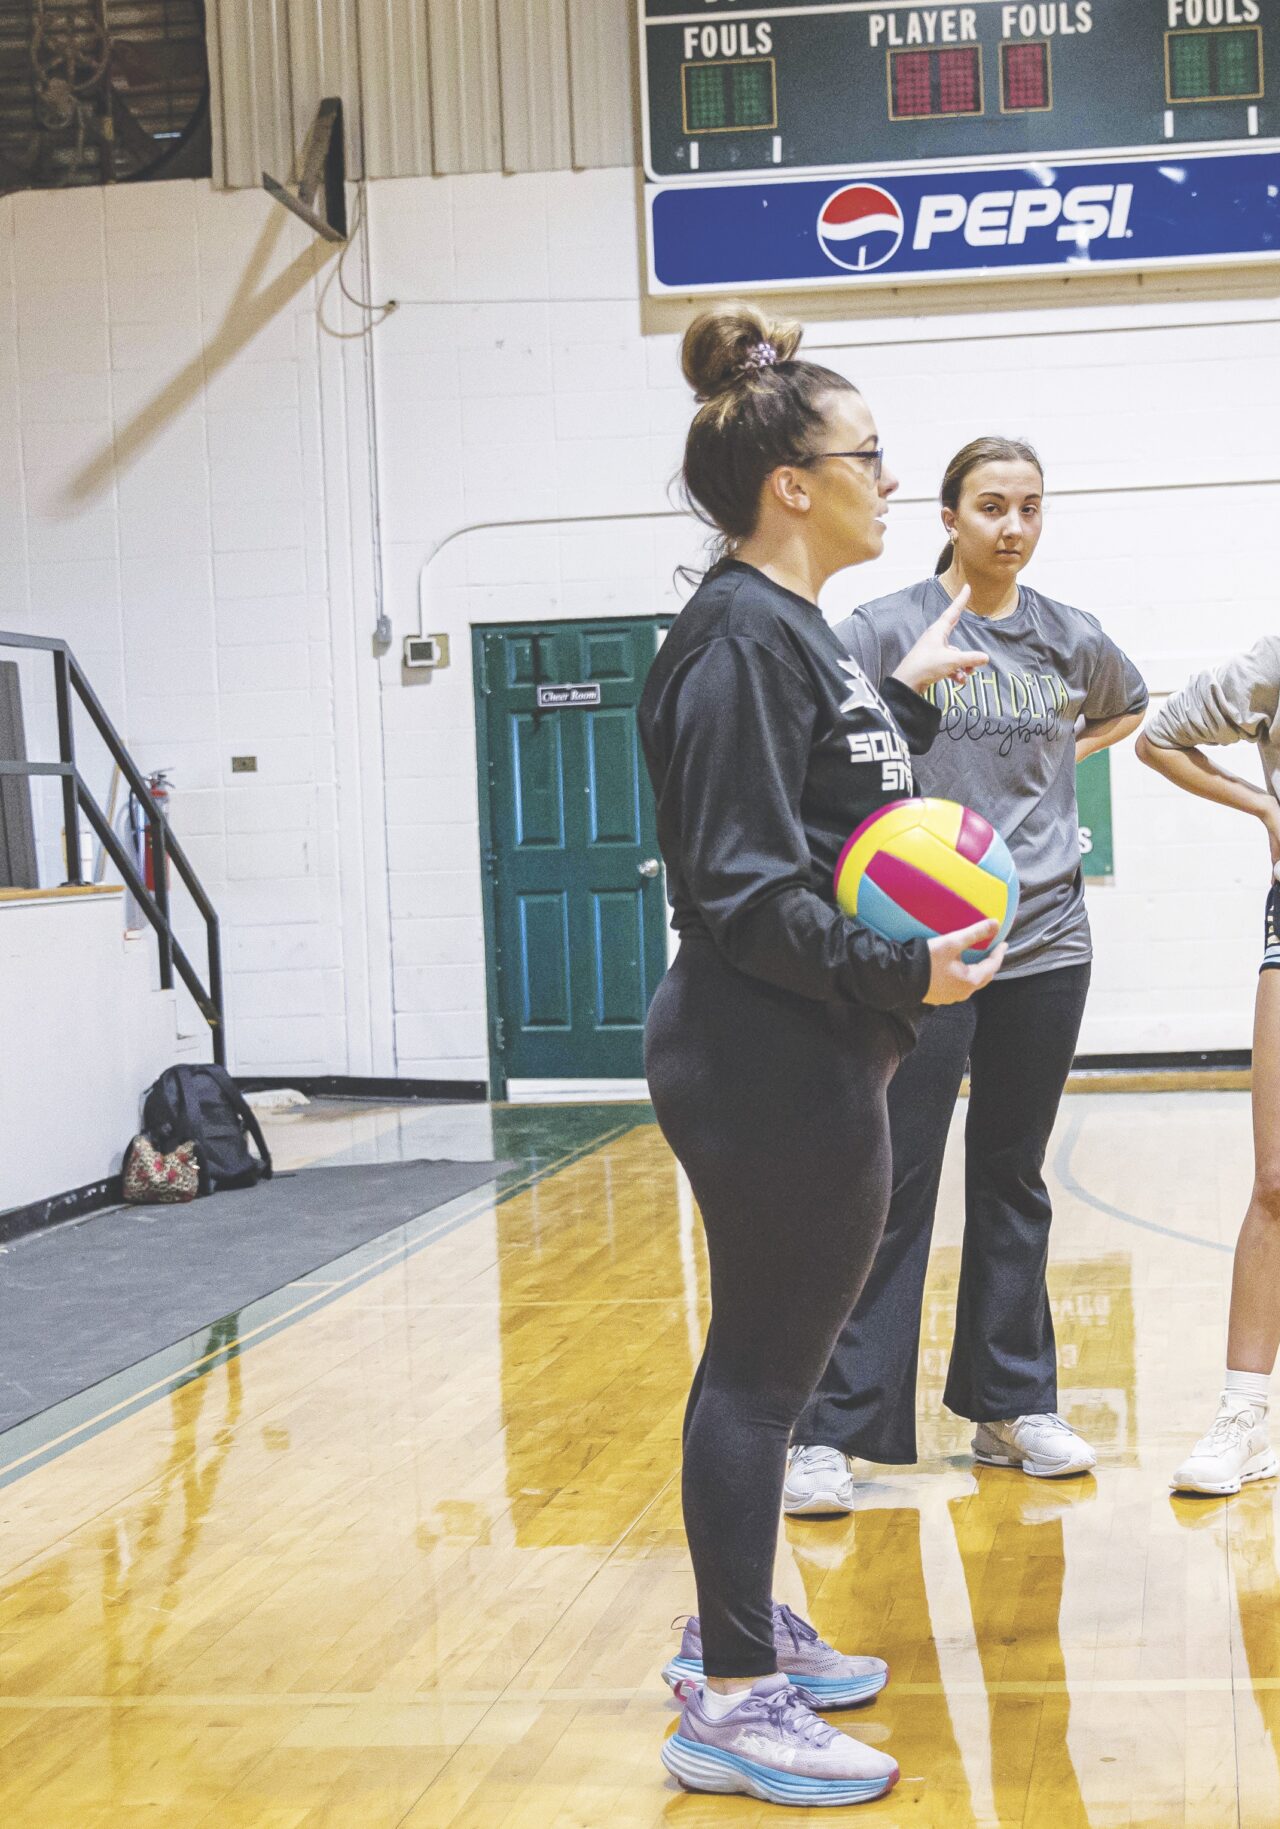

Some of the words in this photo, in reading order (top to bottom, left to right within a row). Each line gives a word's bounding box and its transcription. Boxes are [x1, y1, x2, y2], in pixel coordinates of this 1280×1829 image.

[869, 9, 977, 47] PLAYER
[1001, 1, 1092, 38] FOULS
[1168, 0, 1259, 27] FOULS
[684, 22, 773, 59] FOULS
[913, 184, 1133, 250] PEPSI
[542, 690, 569, 702] Cheer
[570, 688, 597, 701] Room
[923, 671, 1002, 717] ORTH
[1008, 671, 1070, 719] DELTA
